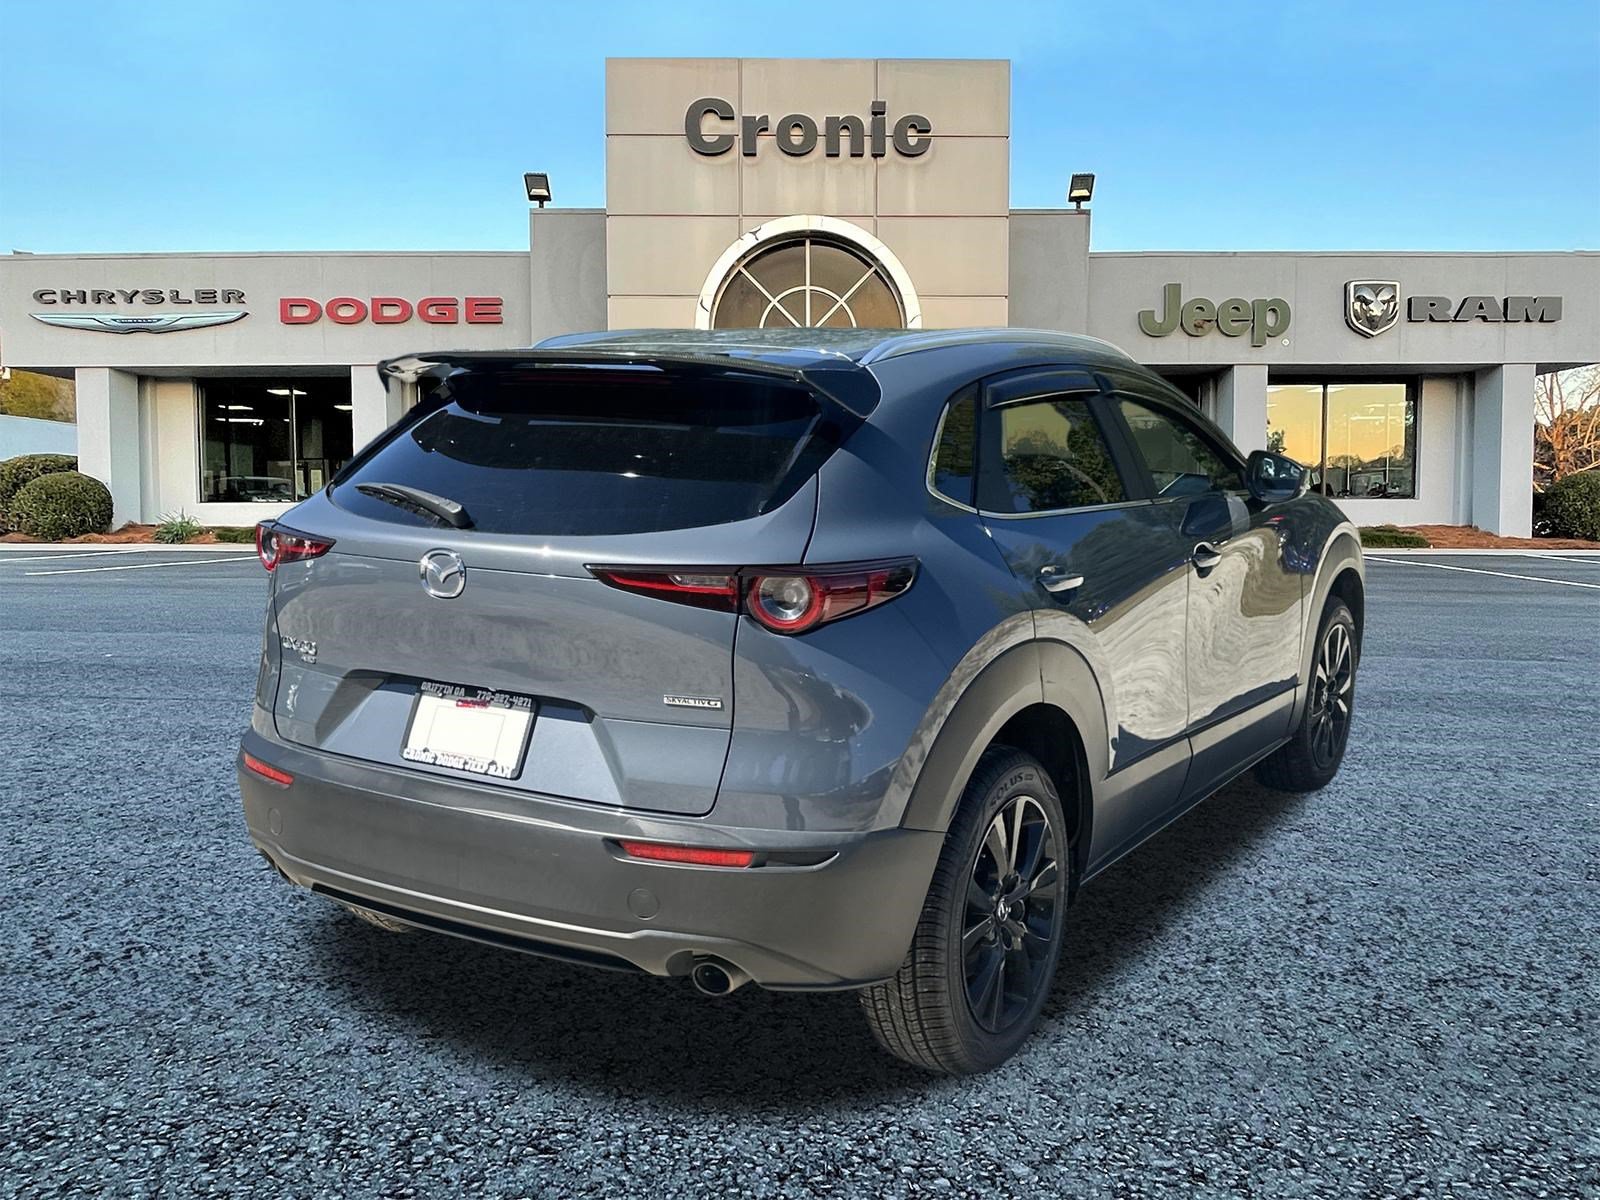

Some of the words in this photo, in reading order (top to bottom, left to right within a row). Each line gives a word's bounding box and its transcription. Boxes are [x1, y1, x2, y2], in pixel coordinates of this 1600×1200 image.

[684, 97, 932, 157] Cronic
[32, 288, 246, 305] CHRYSLER
[1407, 296, 1563, 323] RAM
[279, 297, 504, 325] DODGE
[1138, 283, 1291, 347] Jeep
[421, 682, 454, 695] GRIFFIN
[454, 687, 466, 697] GA
[403, 748, 436, 764] CRONIC
